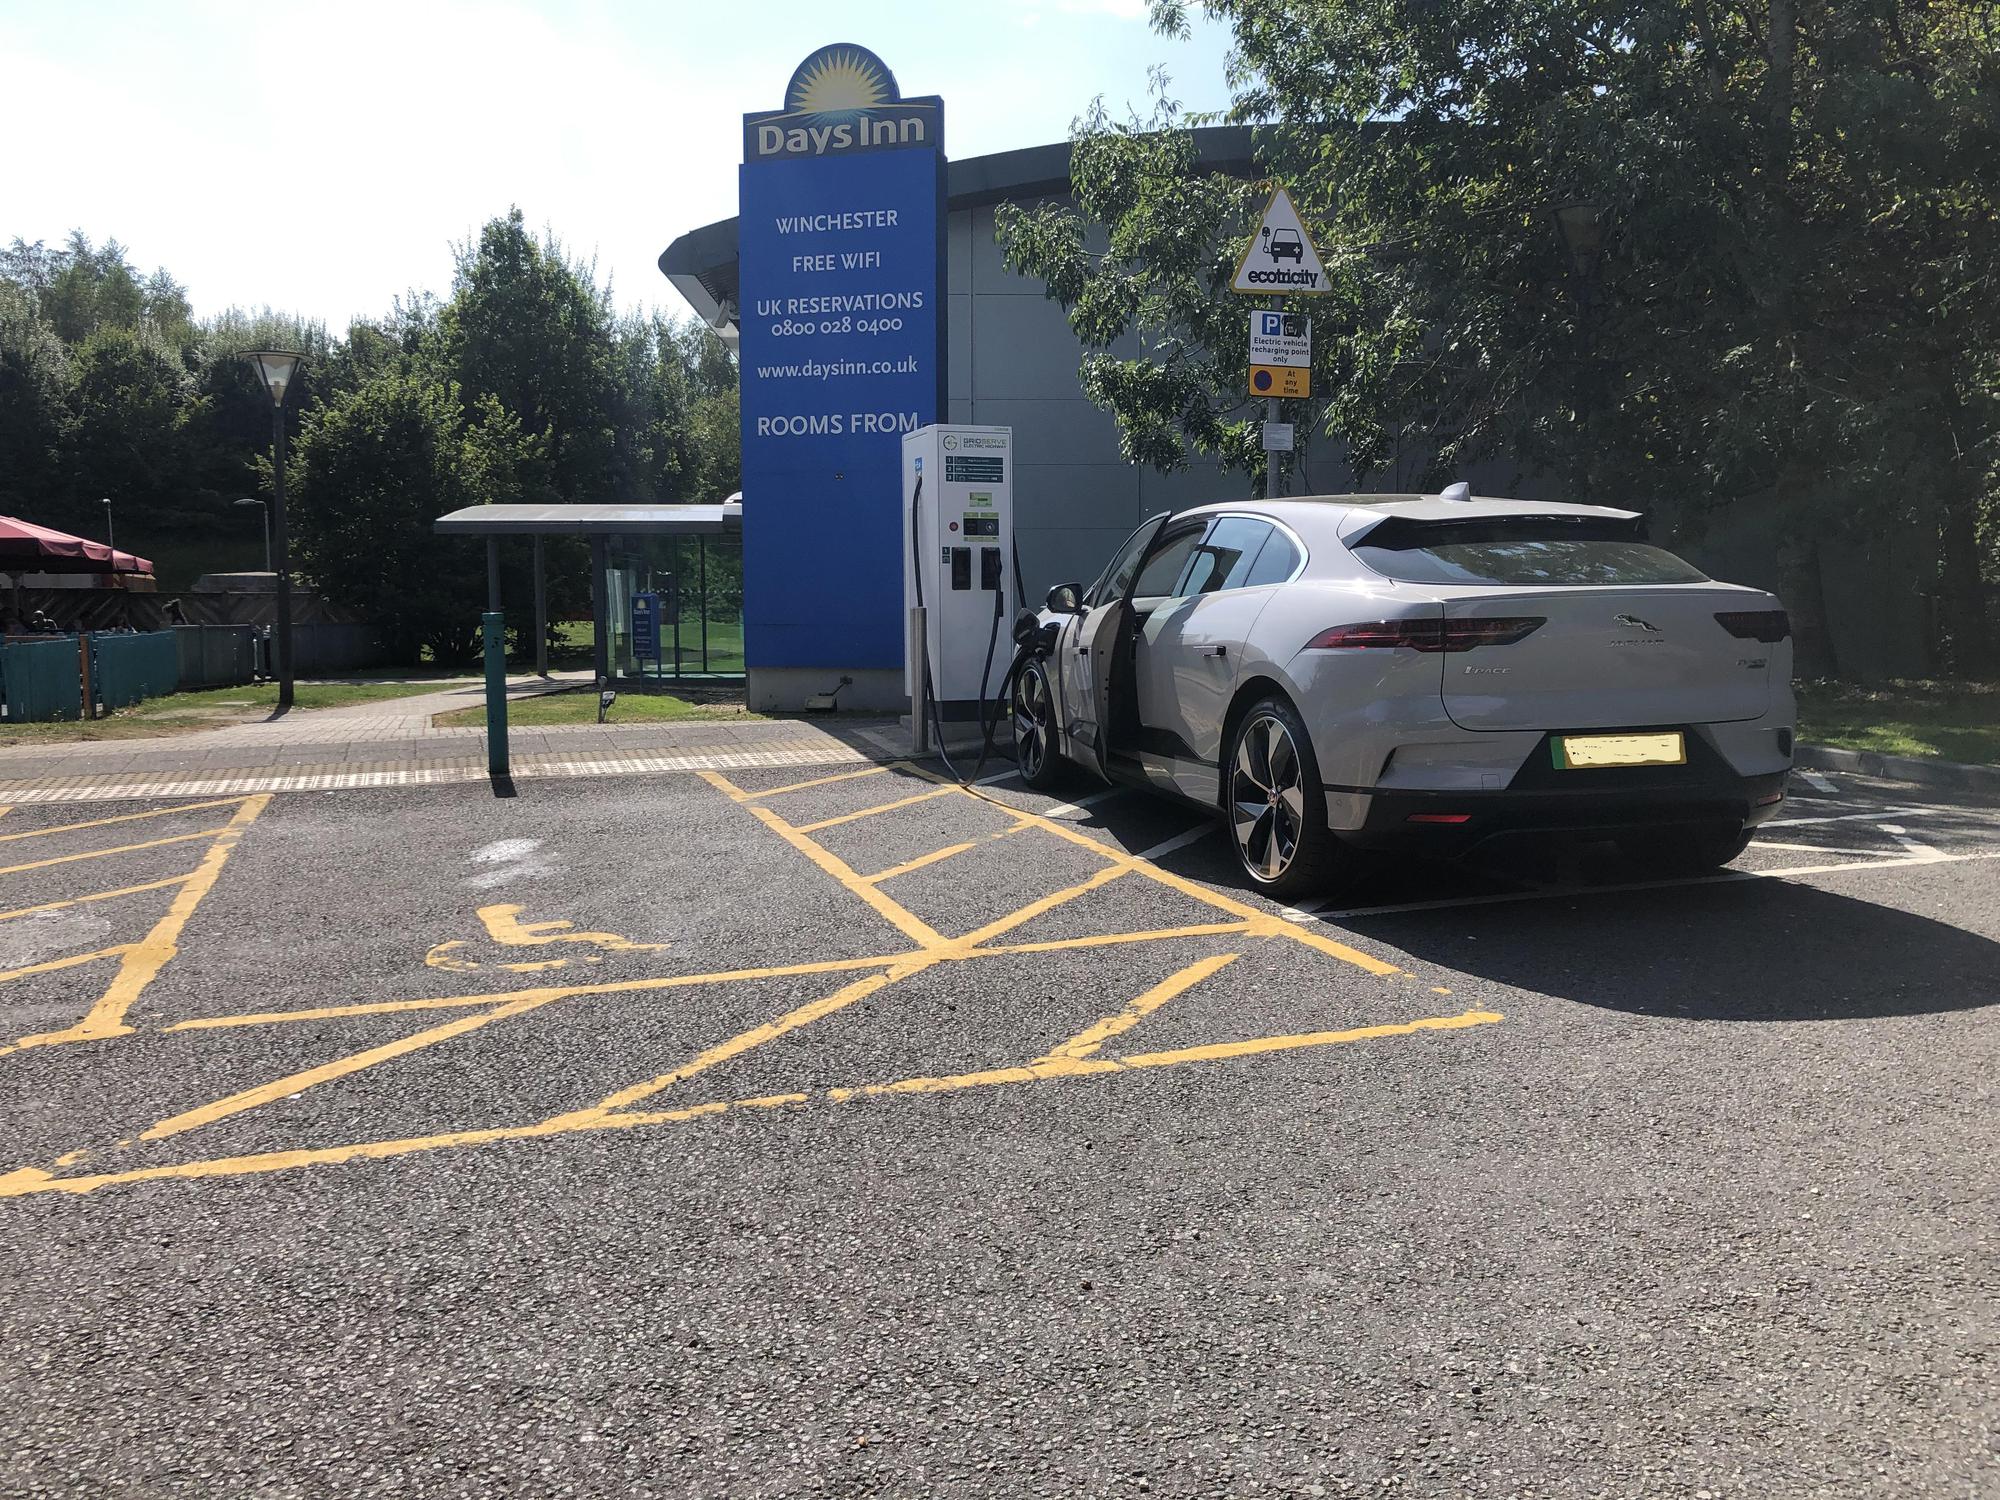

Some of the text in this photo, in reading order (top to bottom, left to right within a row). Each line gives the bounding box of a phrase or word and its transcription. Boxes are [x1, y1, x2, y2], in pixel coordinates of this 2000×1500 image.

[758, 116, 925, 155] Days Inn
[776, 209, 899, 234] WINCHESTER
[792, 251, 881, 273] FREE WIFI
[1248, 268, 1319, 289] ecotricity
[757, 292, 924, 317] UK RESERVATIONS
[771, 316, 903, 337] 0800 028 0400
[1266, 316, 1278, 334] P
[1251, 346, 1310, 357] recharging point
[1253, 337, 1308, 348] Electric vehicle
[757, 354, 918, 381] www.daysinn.co.uk
[1272, 356, 1289, 364] only
[1284, 379, 1298, 387] any
[1287, 370, 1296, 378] At
[1283, 387, 1299, 395] time
[757, 411, 919, 437] ROOMS FROM
[963, 437, 1007, 445] GRIDSERVE
